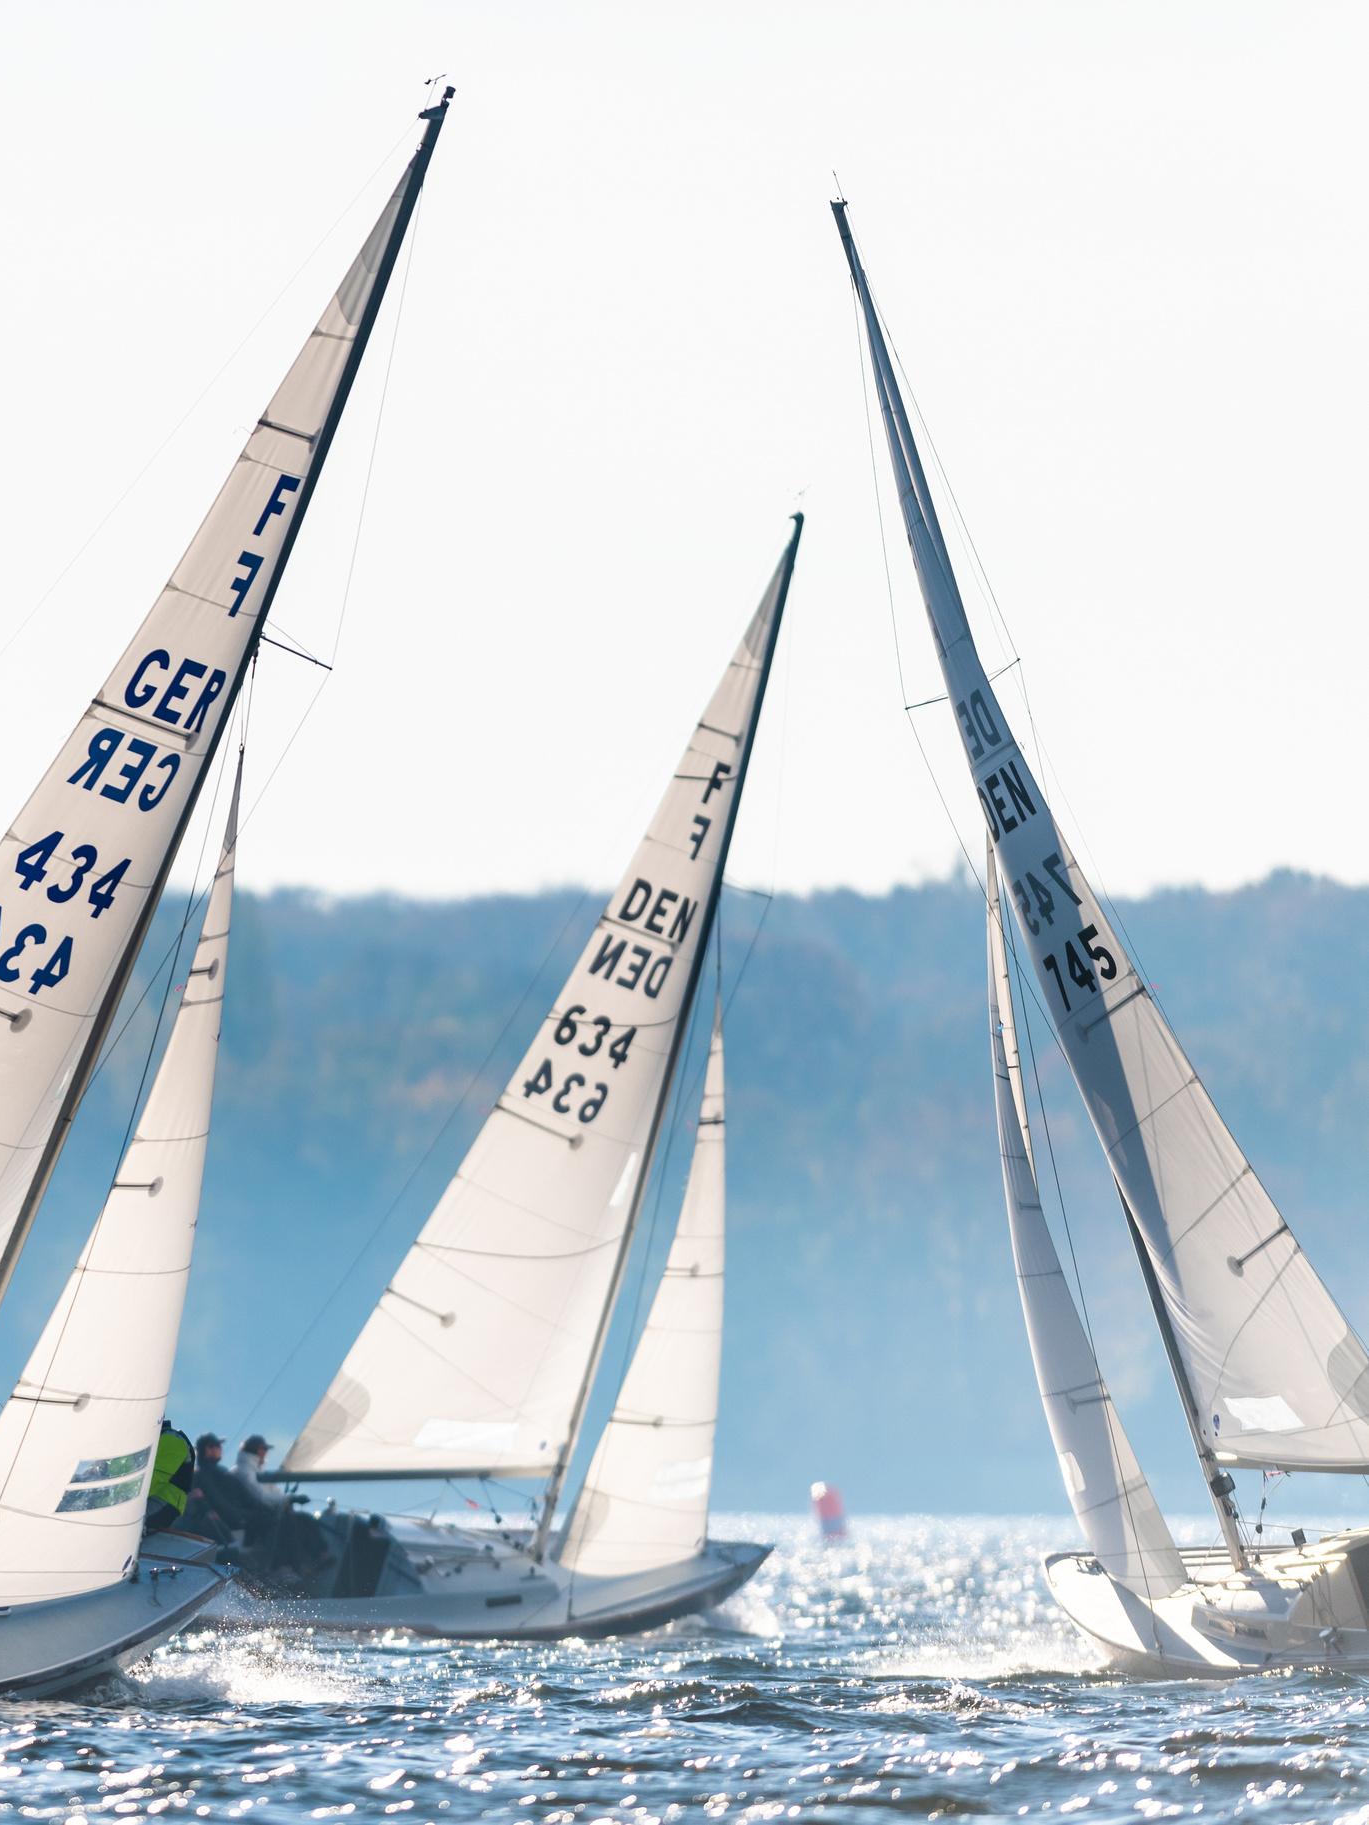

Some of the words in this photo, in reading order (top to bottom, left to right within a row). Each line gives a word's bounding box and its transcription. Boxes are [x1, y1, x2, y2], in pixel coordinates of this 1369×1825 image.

[252, 474, 301, 536] F
[124, 649, 227, 733] GER
[703, 761, 731, 804] F
[15, 831, 132, 919] 434
[619, 878, 698, 944] DEN
[554, 1005, 637, 1069] 634
